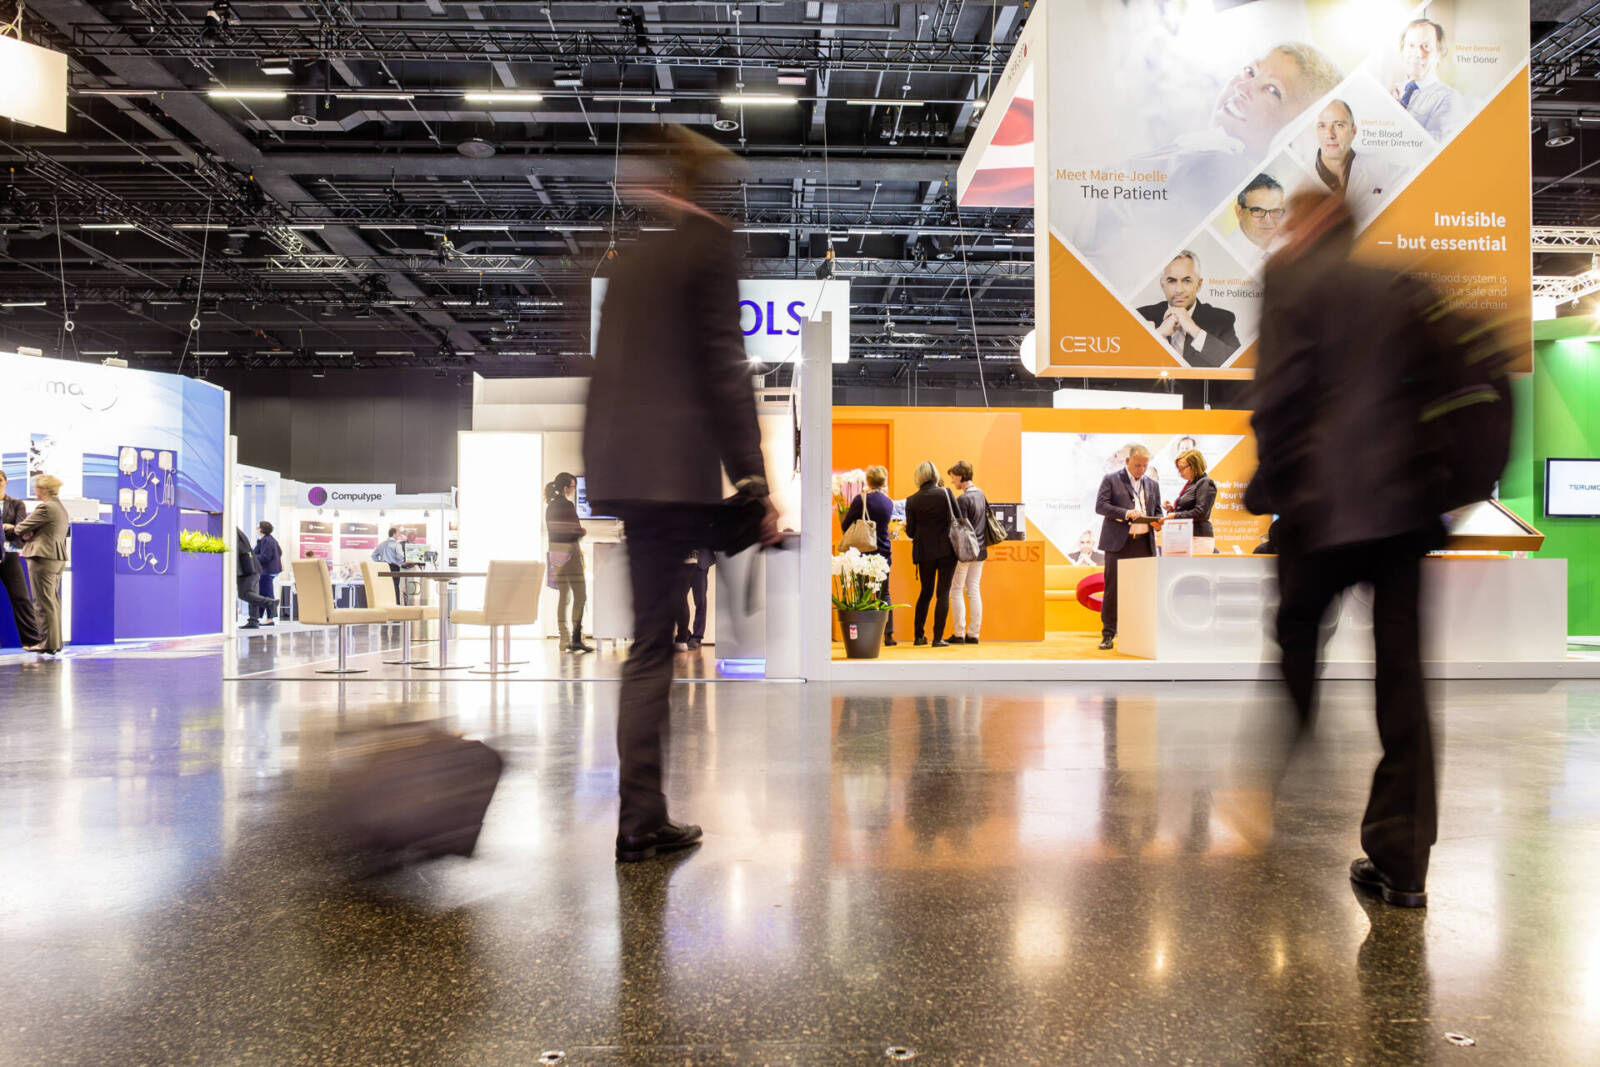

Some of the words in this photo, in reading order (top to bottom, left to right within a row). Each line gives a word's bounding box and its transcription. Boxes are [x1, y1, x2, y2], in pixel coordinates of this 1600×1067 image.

[1457, 56, 1471, 64] The
[1473, 56, 1498, 64] Donor
[1362, 129, 1376, 137] The
[1379, 129, 1403, 138] Blood
[1361, 139, 1388, 147] Center
[1391, 140, 1424, 148] Director
[1056, 169, 1086, 181] Meet
[1090, 169, 1168, 182] Marie-Joelle
[1080, 185, 1109, 199] The
[1113, 186, 1168, 200] Patient
[1434, 211, 1507, 228] Invisible
[1397, 234, 1427, 249] but
[1430, 235, 1507, 251] essential
[1462, 273, 1497, 286] system
[1499, 274, 1508, 284] is
[1209, 289, 1225, 297] The
[1465, 285, 1487, 297] safe
[1488, 286, 1508, 298] and
[1480, 299, 1508, 311] chain
[739, 300, 806, 336] OLS
[1059, 335, 1121, 353] CERUS
[331, 491, 382, 502] Computype
[986, 546, 1040, 562] ERUS
